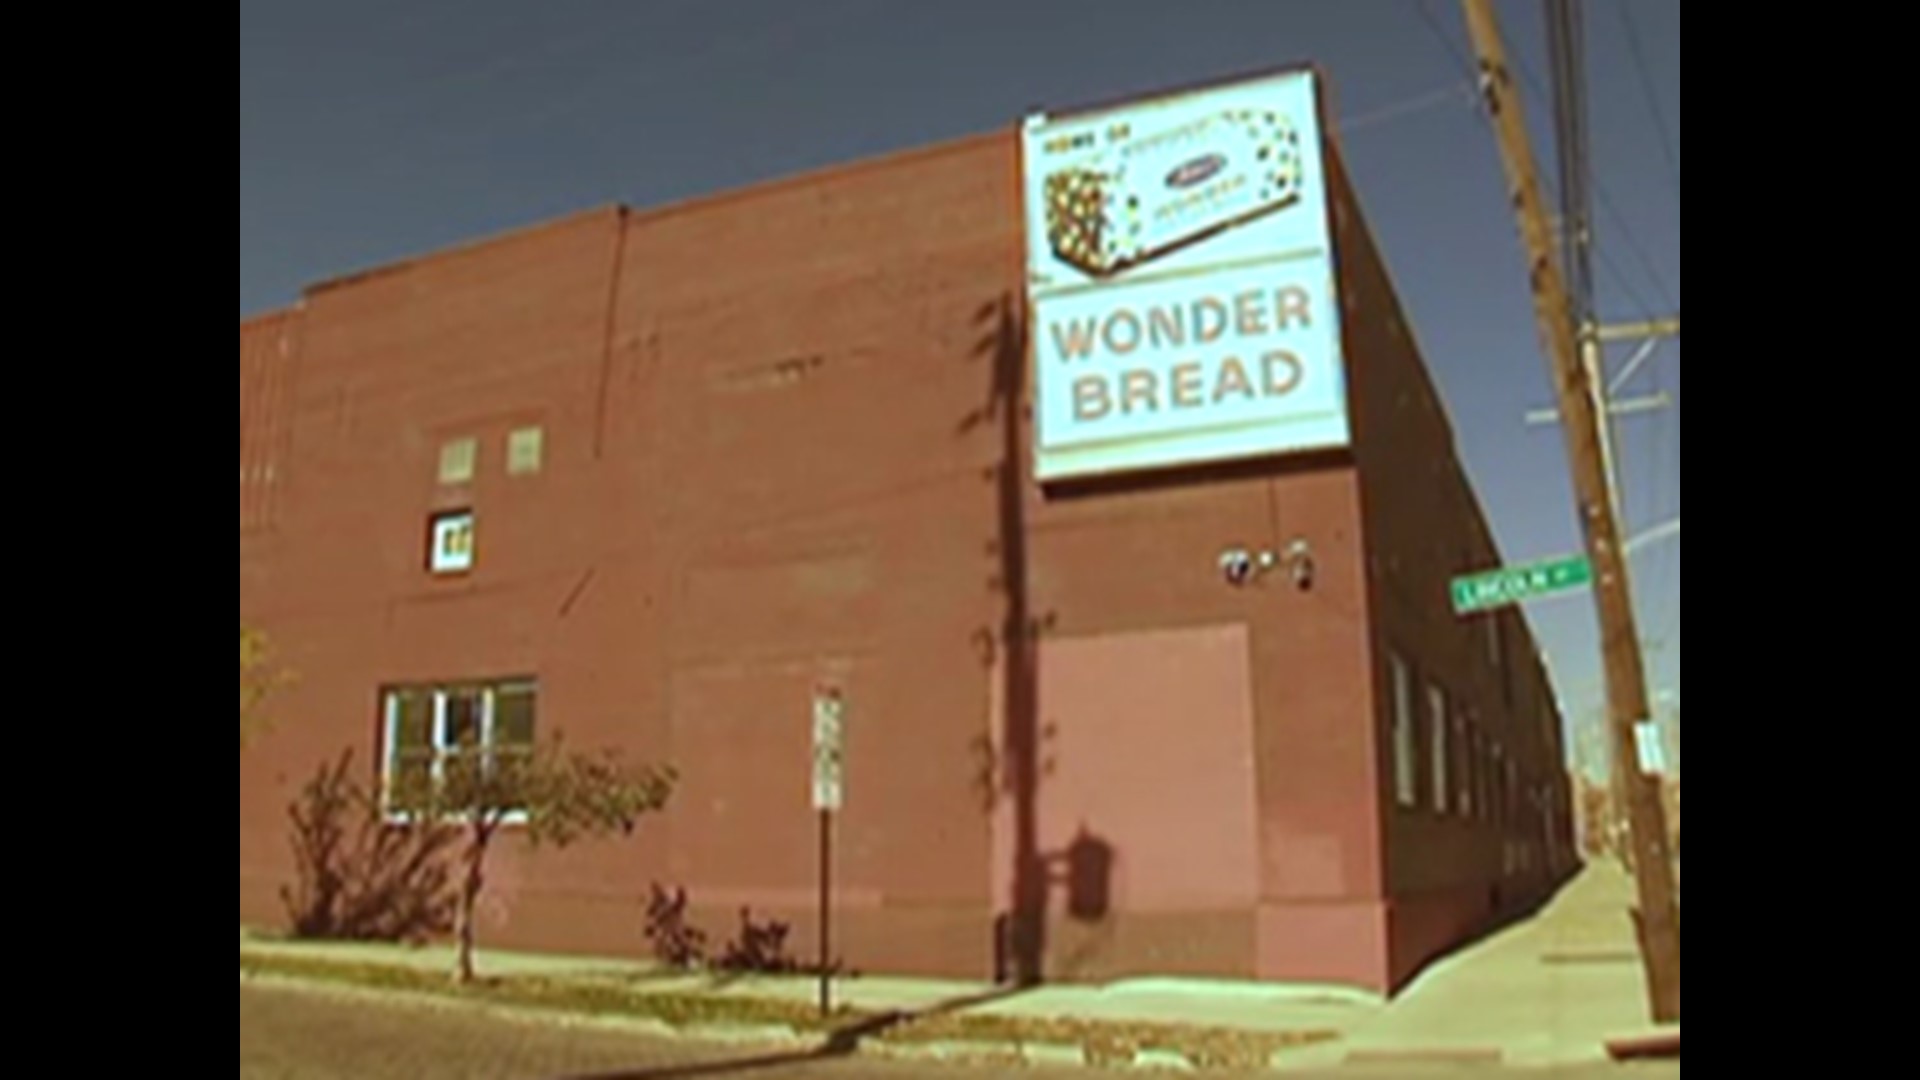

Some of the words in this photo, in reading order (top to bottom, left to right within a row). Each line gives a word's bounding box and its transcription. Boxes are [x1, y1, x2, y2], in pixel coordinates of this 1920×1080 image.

[1050, 285, 1312, 363] WONDER
[1072, 350, 1304, 423] BREAD
[1461, 570, 1549, 606] LINCOLN
